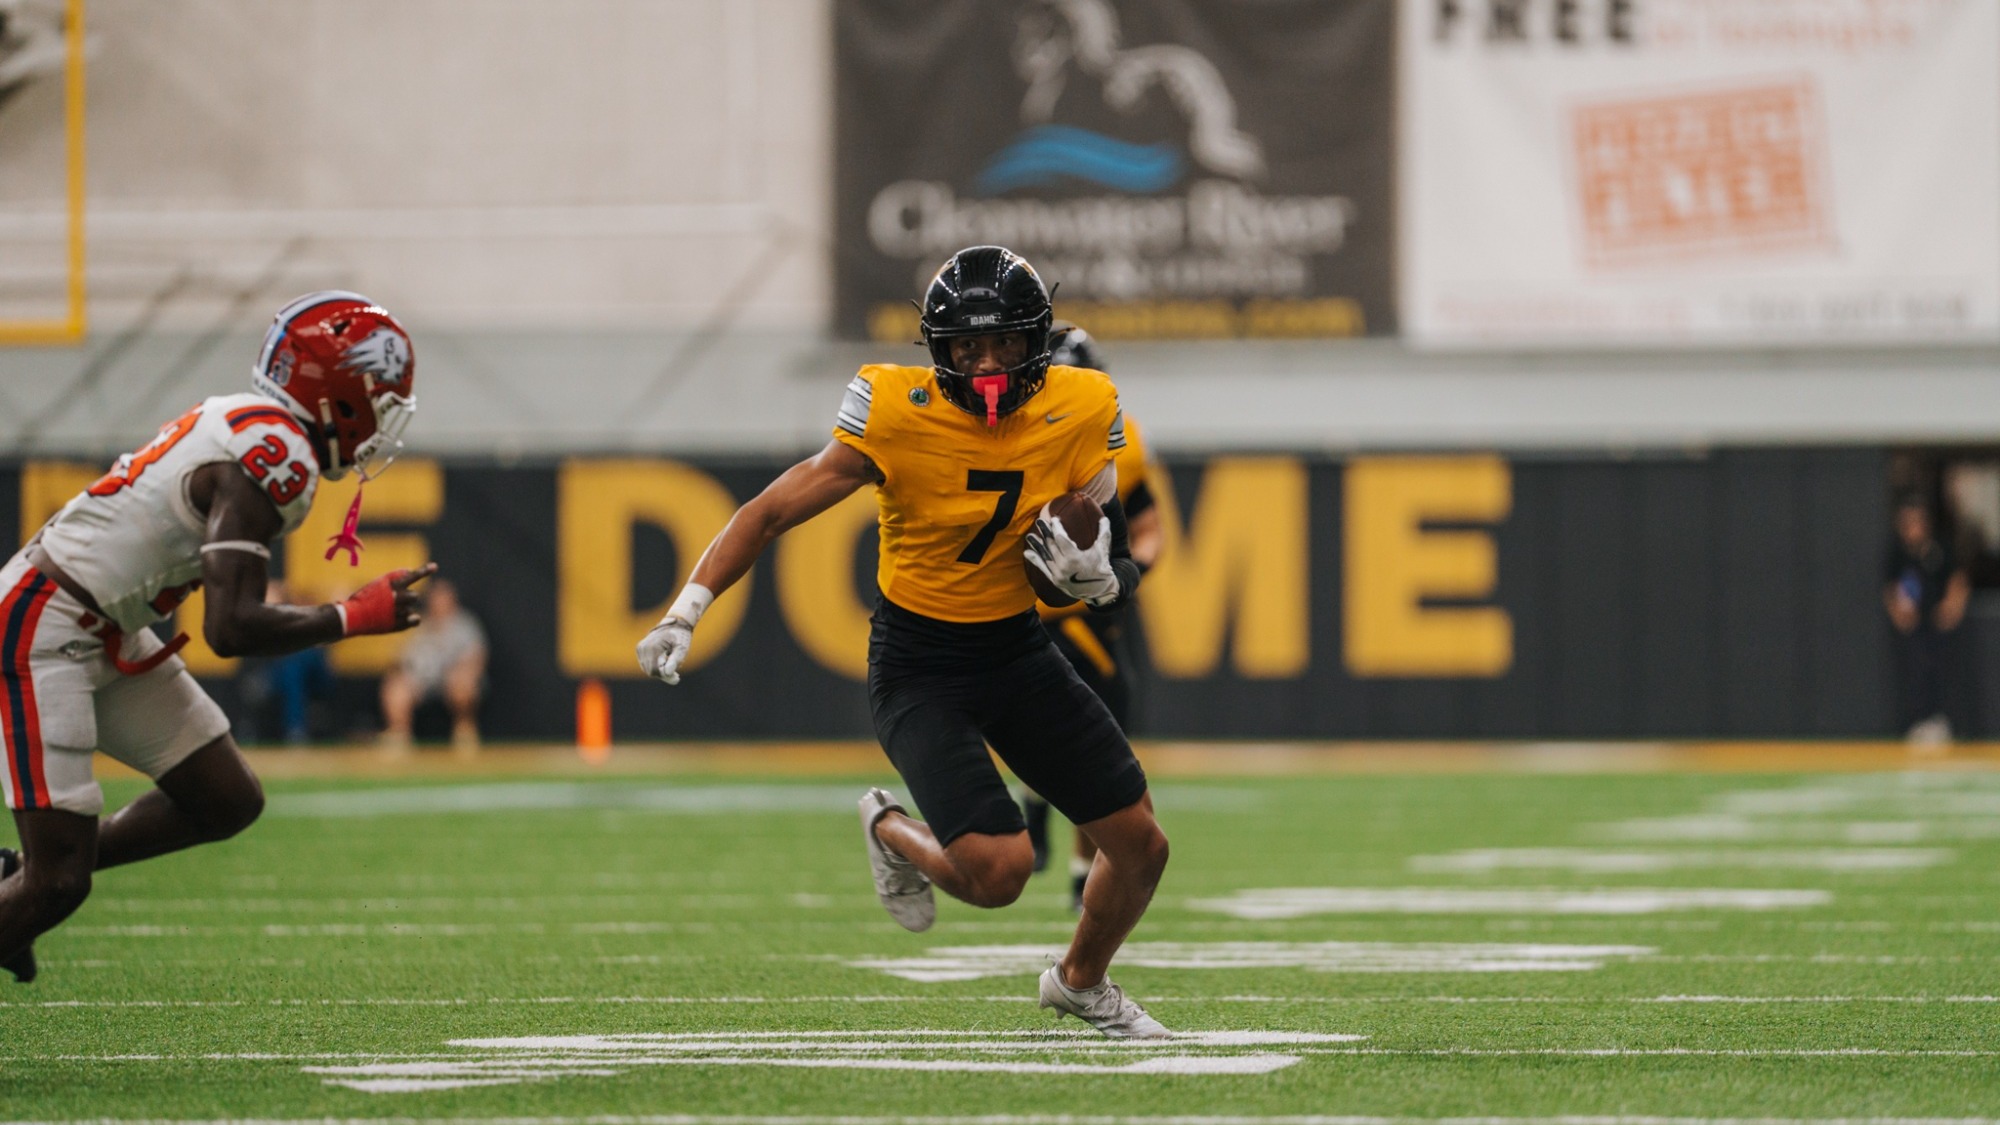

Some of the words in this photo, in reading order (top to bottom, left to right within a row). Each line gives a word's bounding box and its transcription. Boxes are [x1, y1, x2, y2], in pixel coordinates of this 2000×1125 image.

[970, 314, 996, 326] IDAHO
[241, 433, 310, 507] 23
[956, 469, 1024, 565] 7
